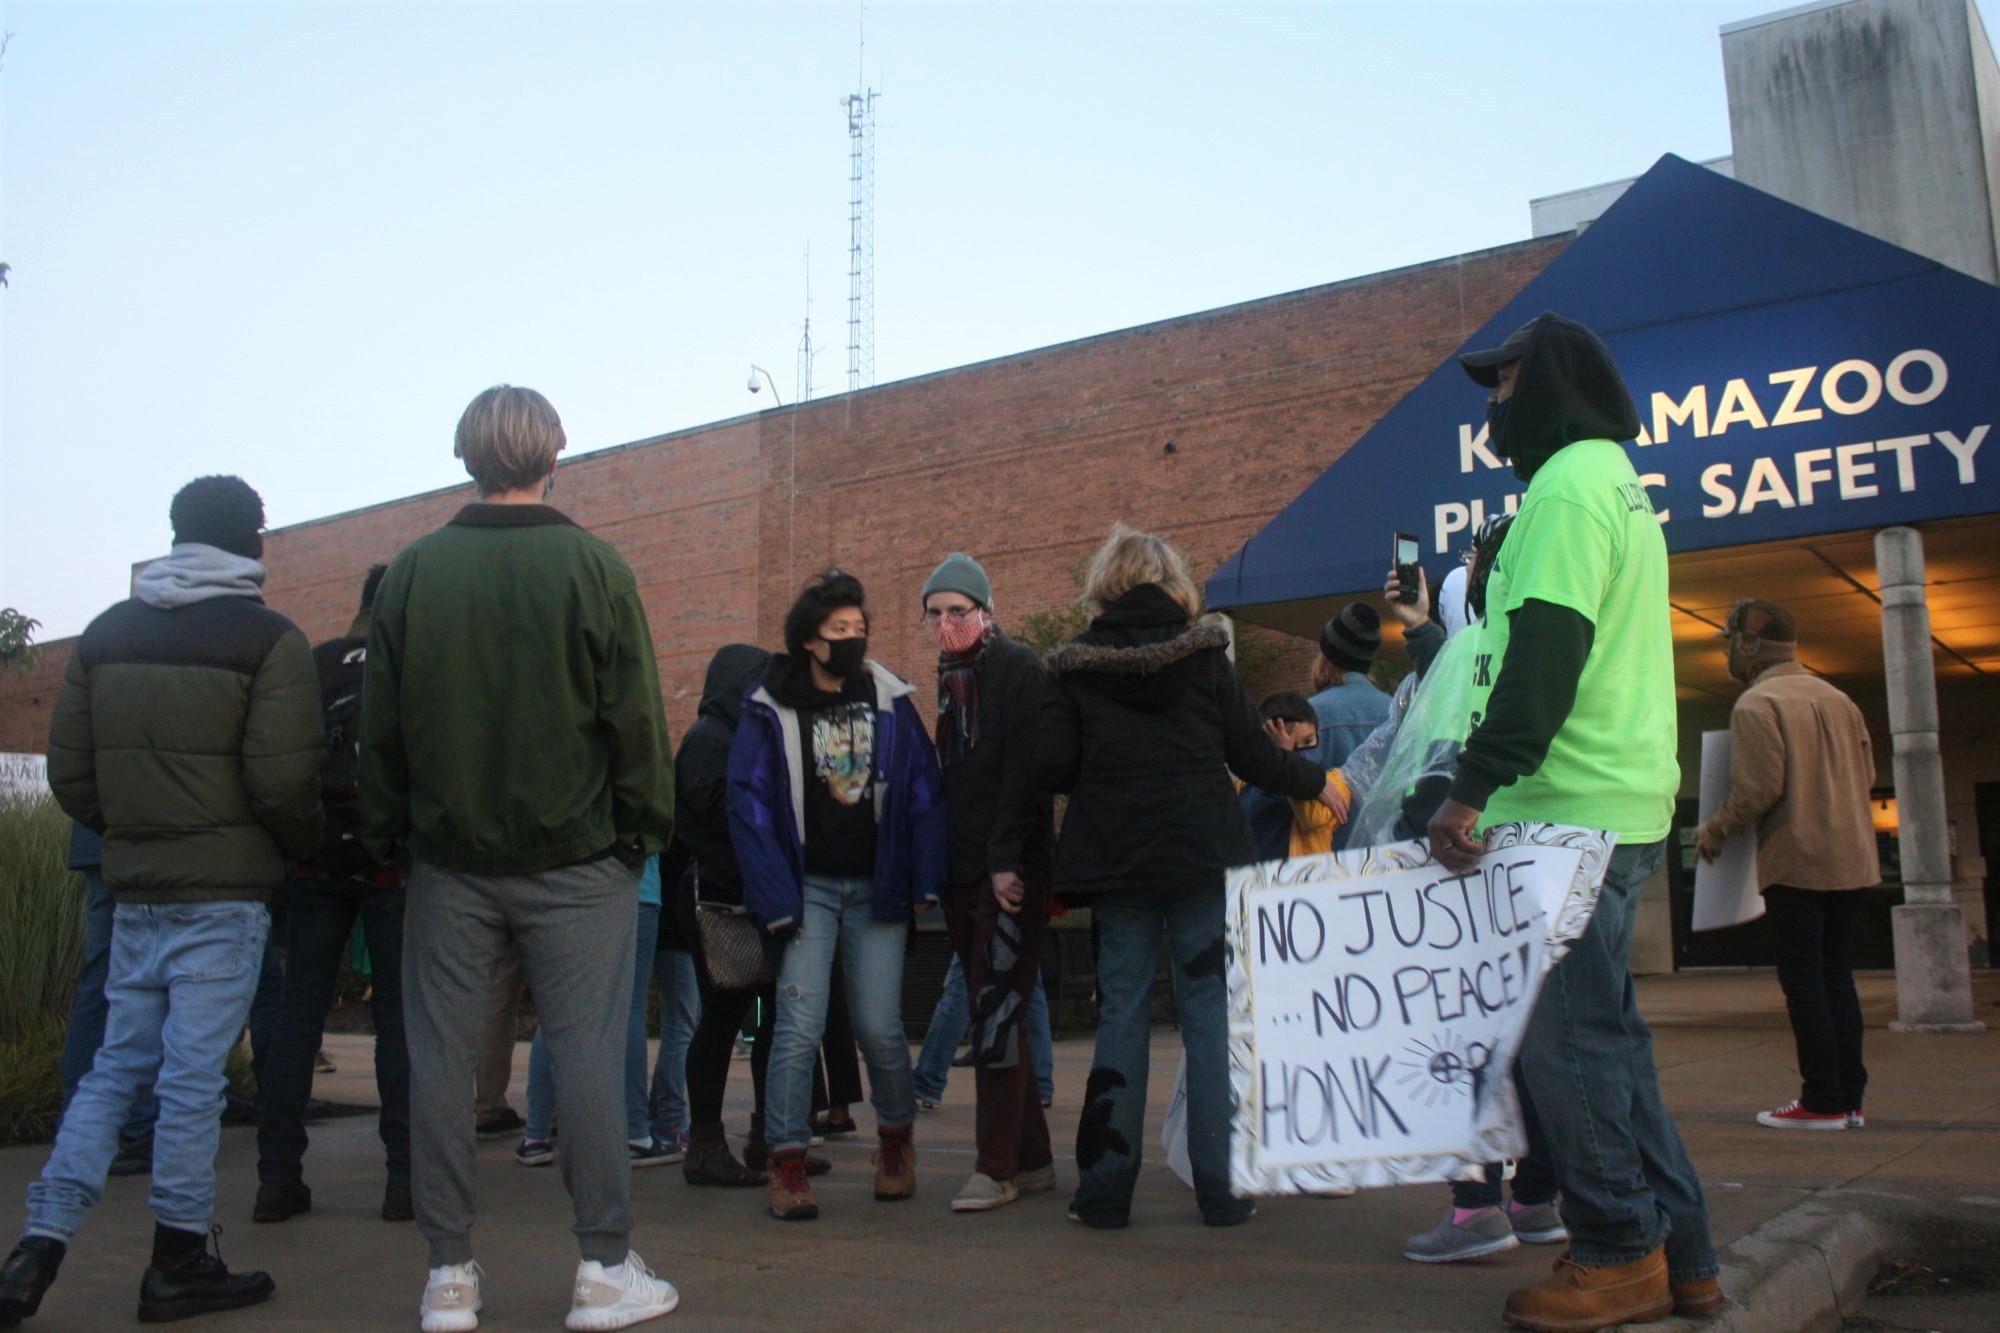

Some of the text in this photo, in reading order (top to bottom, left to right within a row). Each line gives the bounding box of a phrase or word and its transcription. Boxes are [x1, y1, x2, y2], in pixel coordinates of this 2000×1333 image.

[1458, 348, 1949, 474] KMAZOO
[1700, 424, 1992, 519] SAFETY
[1257, 898, 1326, 966] NO
[1260, 1053, 1411, 1149] HONK
